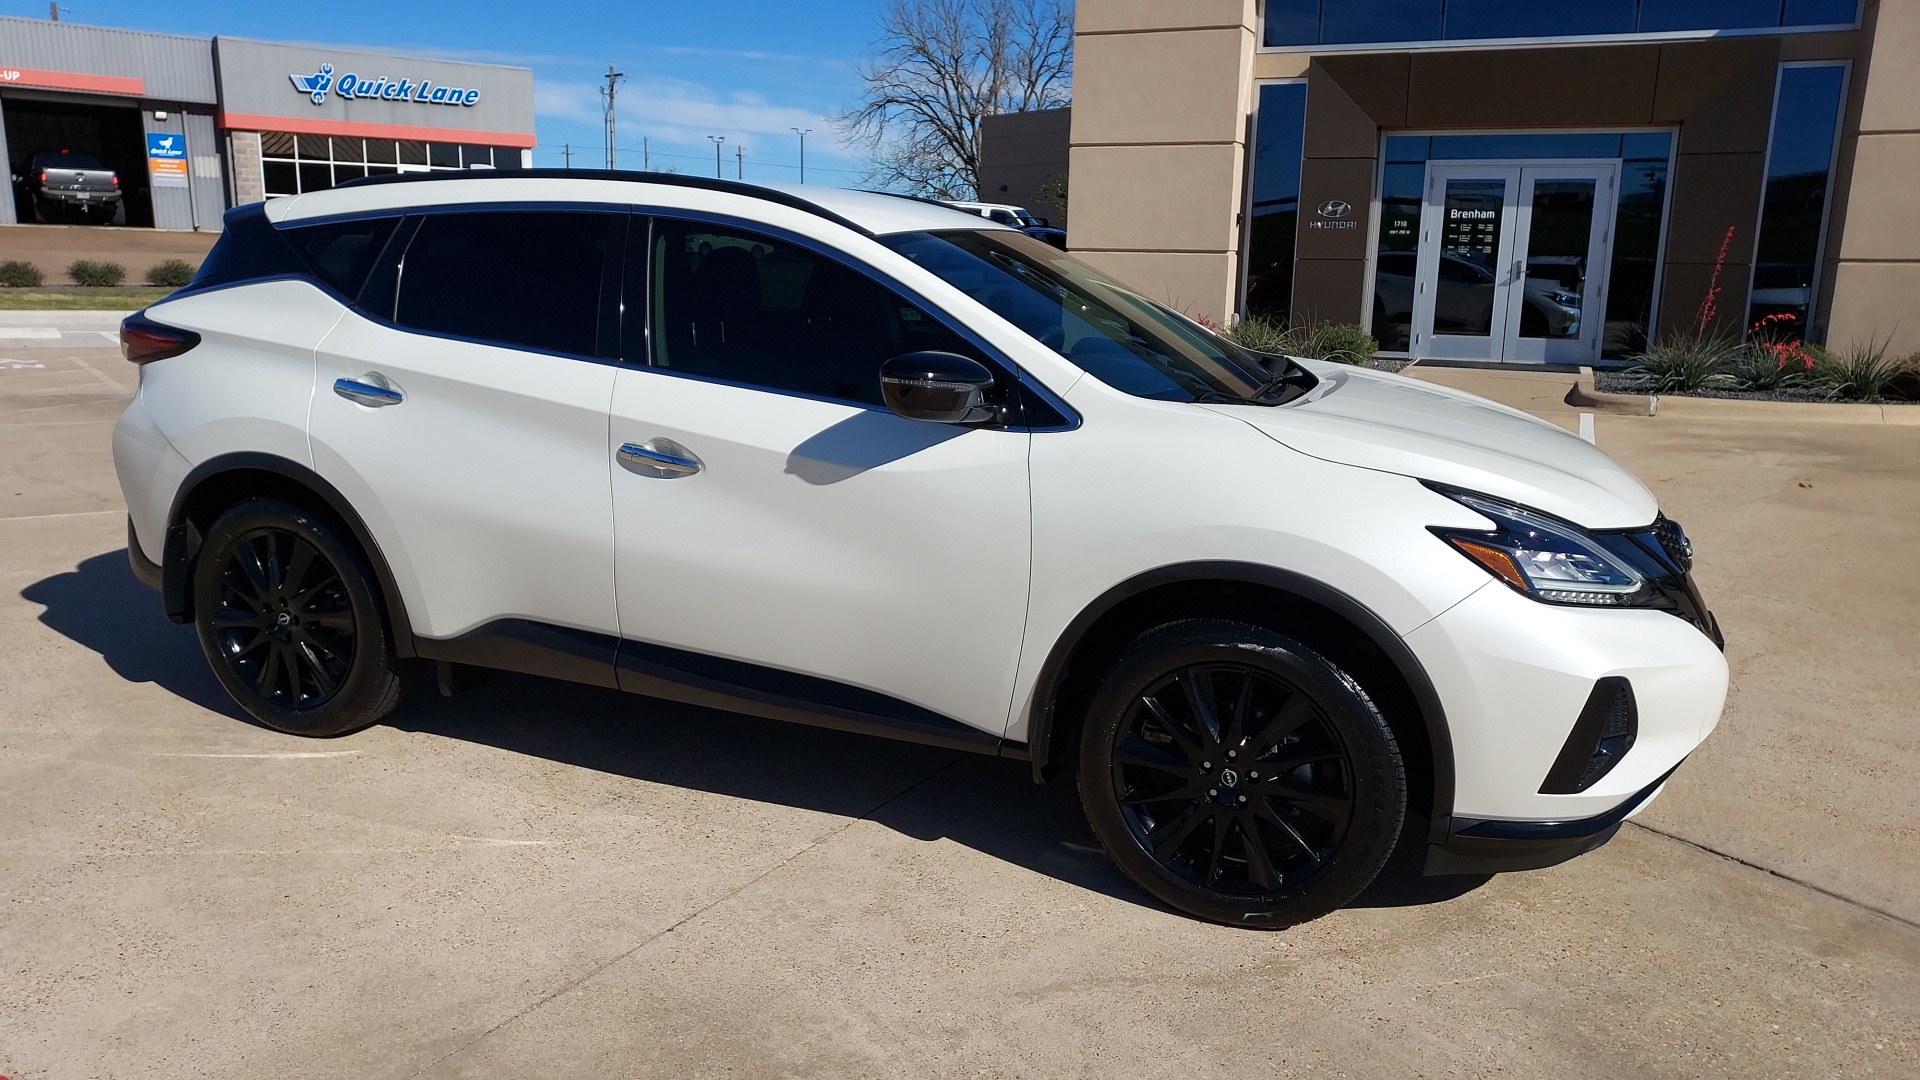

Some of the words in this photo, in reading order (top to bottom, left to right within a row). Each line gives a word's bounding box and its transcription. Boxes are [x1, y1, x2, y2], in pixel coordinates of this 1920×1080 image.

[336, 73, 417, 100] Quick
[414, 79, 480, 106] Lane
[1450, 208, 1496, 219] Brenham
[1309, 221, 1358, 229] HYUNDAI
